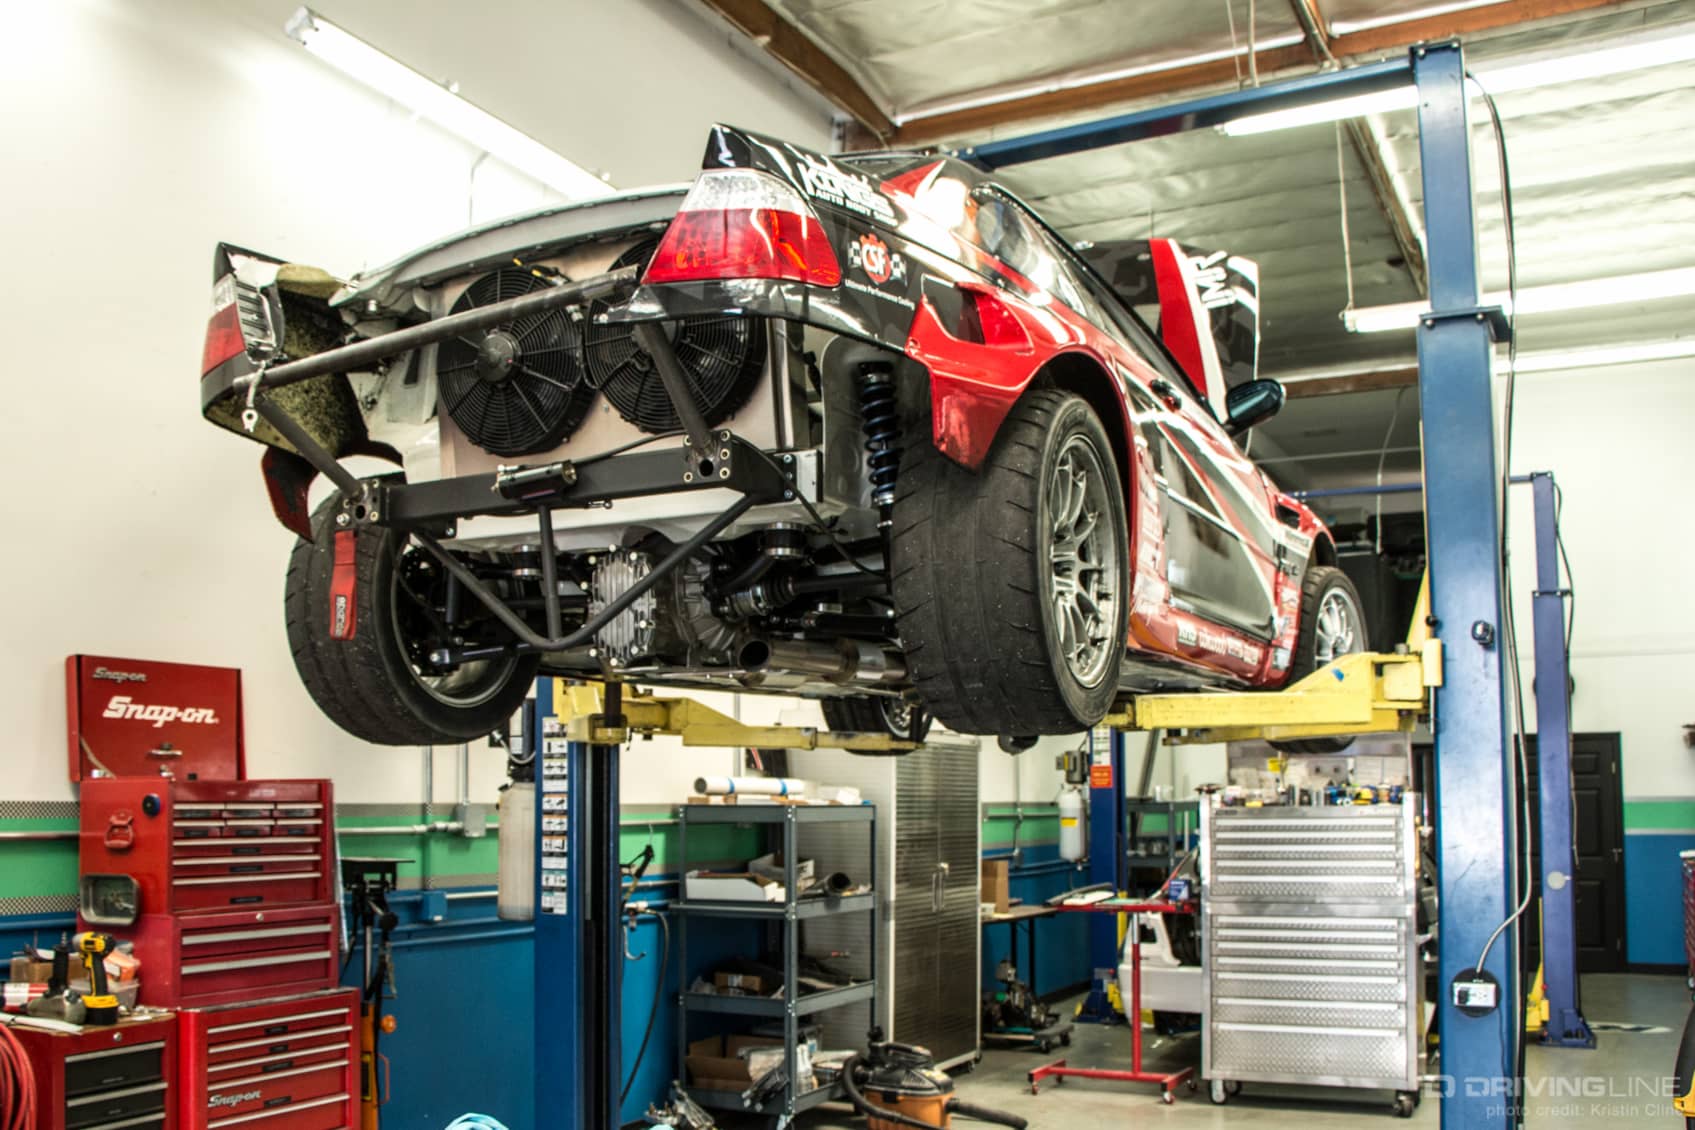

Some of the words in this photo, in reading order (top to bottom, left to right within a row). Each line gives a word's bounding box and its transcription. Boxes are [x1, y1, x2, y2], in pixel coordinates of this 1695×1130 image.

[862, 243, 886, 276] CSF
[92, 667, 147, 683] Snap-on
[102, 695, 216, 728] Snap-on
[207, 1090, 262, 1108] Snap-on
